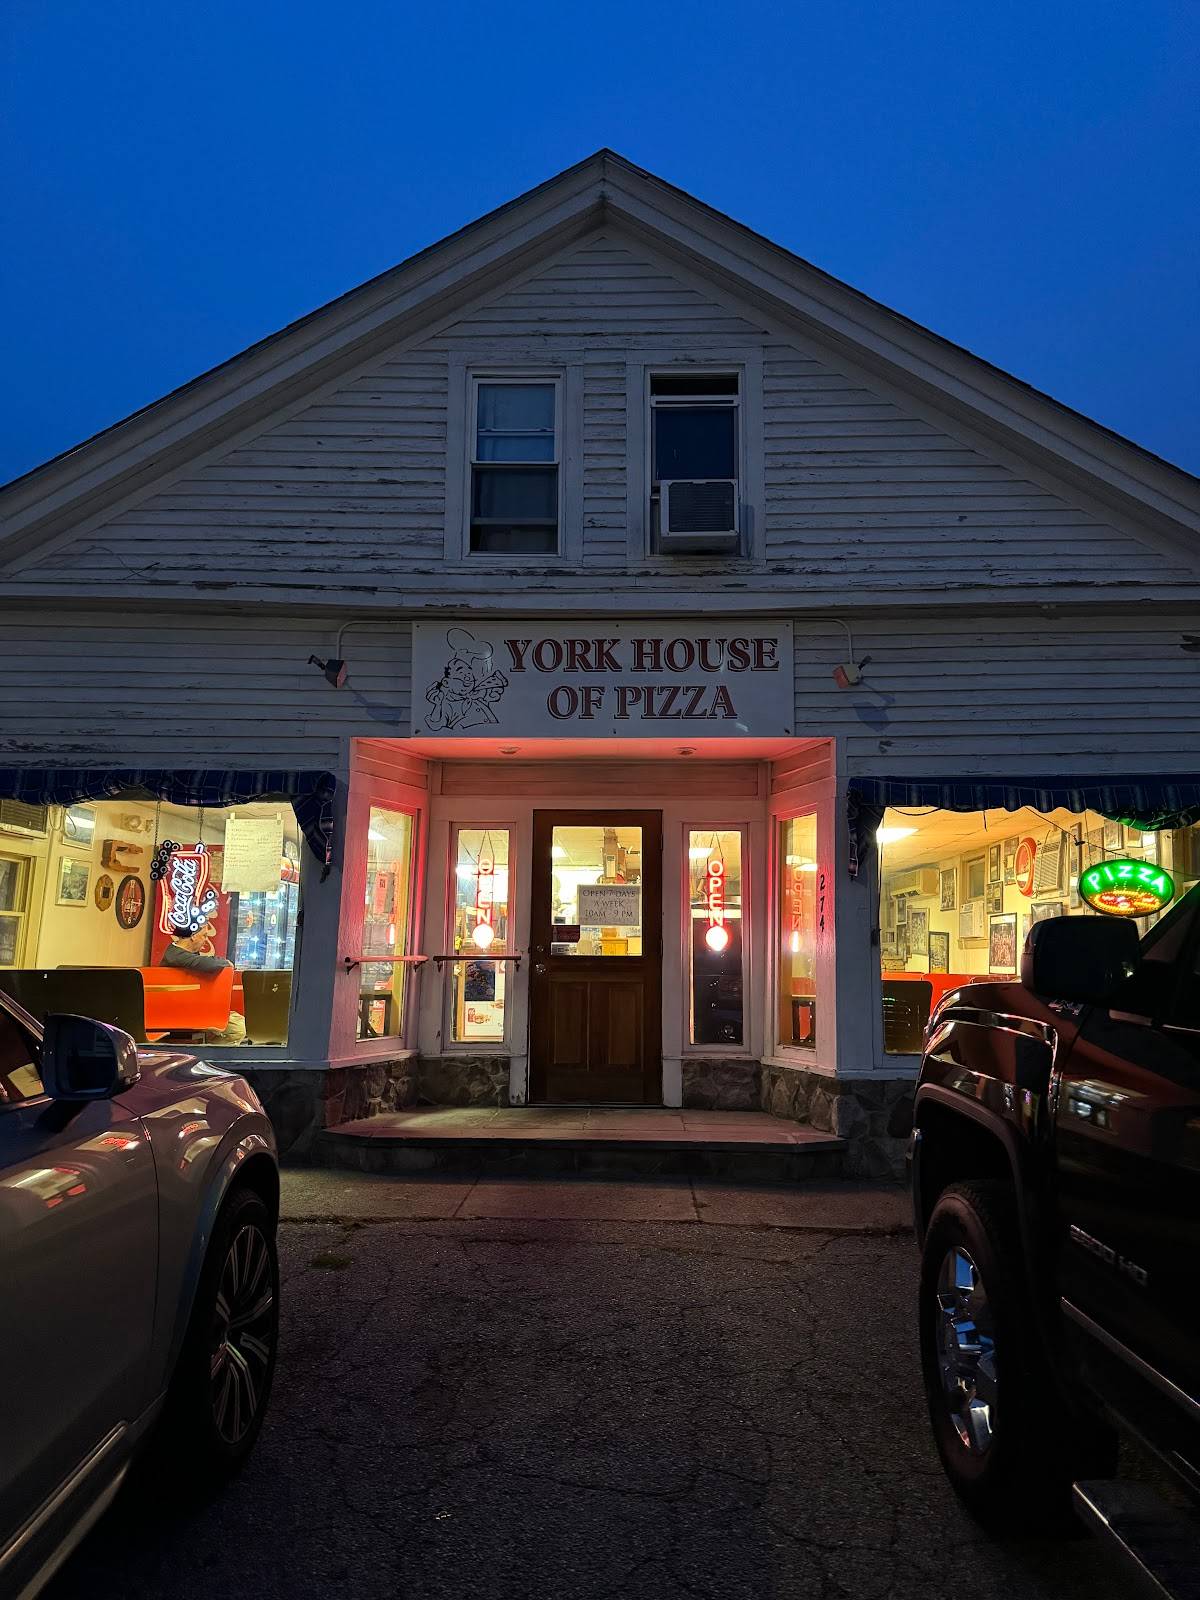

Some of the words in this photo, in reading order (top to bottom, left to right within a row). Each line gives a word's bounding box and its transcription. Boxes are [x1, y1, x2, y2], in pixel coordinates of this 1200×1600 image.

[504, 638, 623, 673] YORK
[630, 638, 780, 673] HOUSE
[547, 685, 605, 720] OF
[613, 685, 738, 720] PIZZA
[477, 858, 493, 925] OEN
[582, 889, 606, 897] OPEN
[708, 860, 725, 927] OPEN
[1087, 865, 1165, 894] PIZZA
